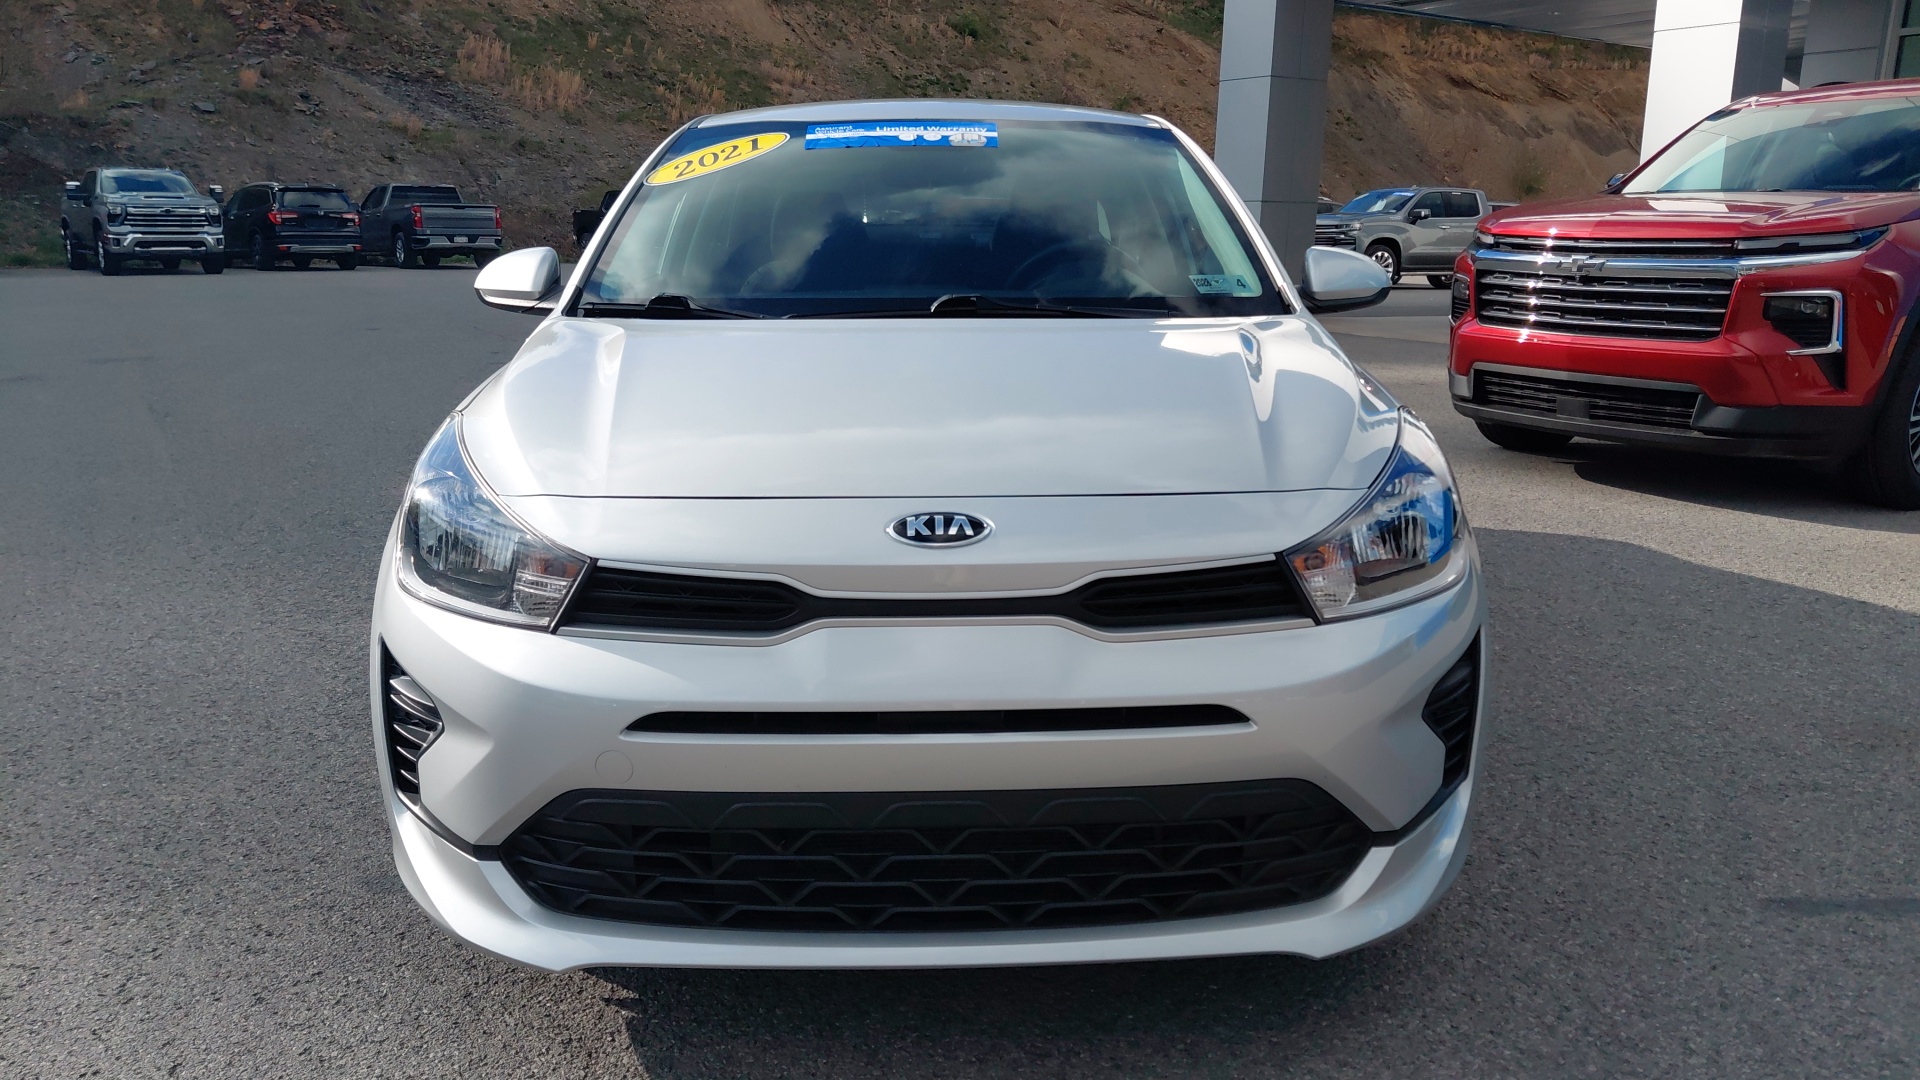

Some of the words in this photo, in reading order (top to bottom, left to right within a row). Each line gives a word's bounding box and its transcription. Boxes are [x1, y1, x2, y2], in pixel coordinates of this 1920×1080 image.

[674, 137, 763, 179] 2021
[1236, 278, 1247, 289] 4
[906, 515, 975, 536] KIA
